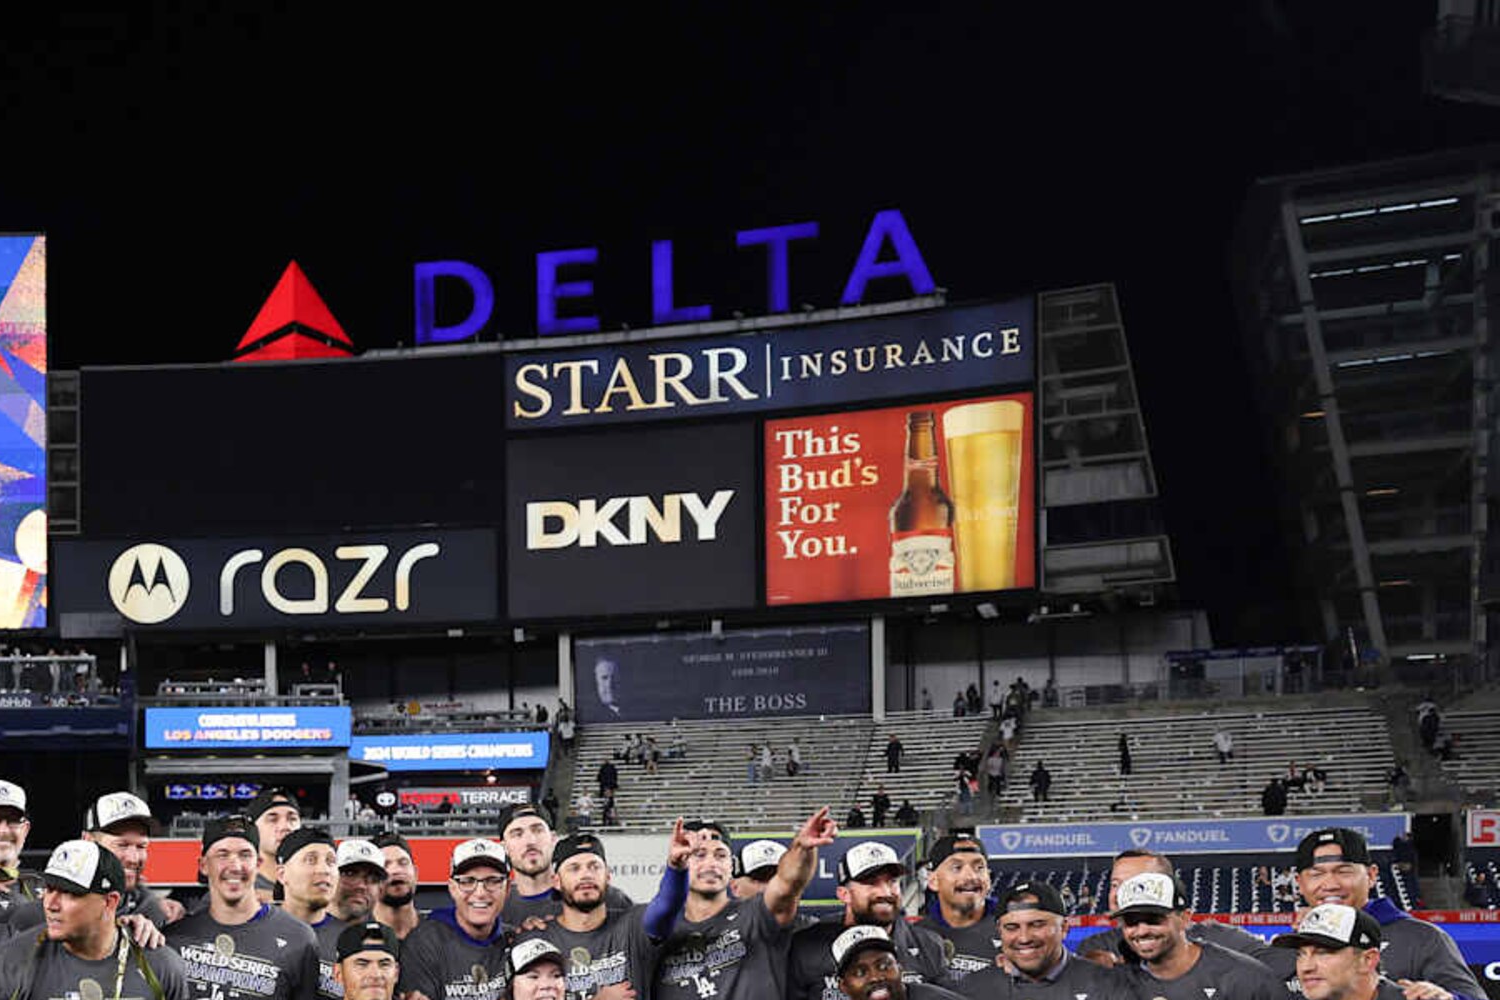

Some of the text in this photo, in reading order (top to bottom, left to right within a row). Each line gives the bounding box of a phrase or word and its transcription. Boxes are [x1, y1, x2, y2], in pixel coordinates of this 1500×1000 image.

[413, 209, 937, 345] DELTA
[513, 327, 1022, 419] STARR INSURANCE
[776, 425, 861, 460] This
[778, 457, 880, 494] Bud's
[526, 490, 735, 550] DKNY
[778, 496, 841, 526] For
[776, 529, 858, 560] You.
[219, 542, 440, 616] razr
[705, 693, 808, 713] THE BOSS
[164, 728, 332, 741] LOS ANGELES DODGERS
[394, 747, 430, 760] WORLD
[468, 744, 533, 759] CHAMPIONS
[461, 790, 528, 804] TERRACE
[1024, 833, 1096, 846] FANDUEL
[1154, 829, 1229, 843] FANDUEL
[1293, 826, 1374, 840] FAEL
[180, 946, 280, 980] WORLD SERIES
[694, 973, 719, 1000] LA
